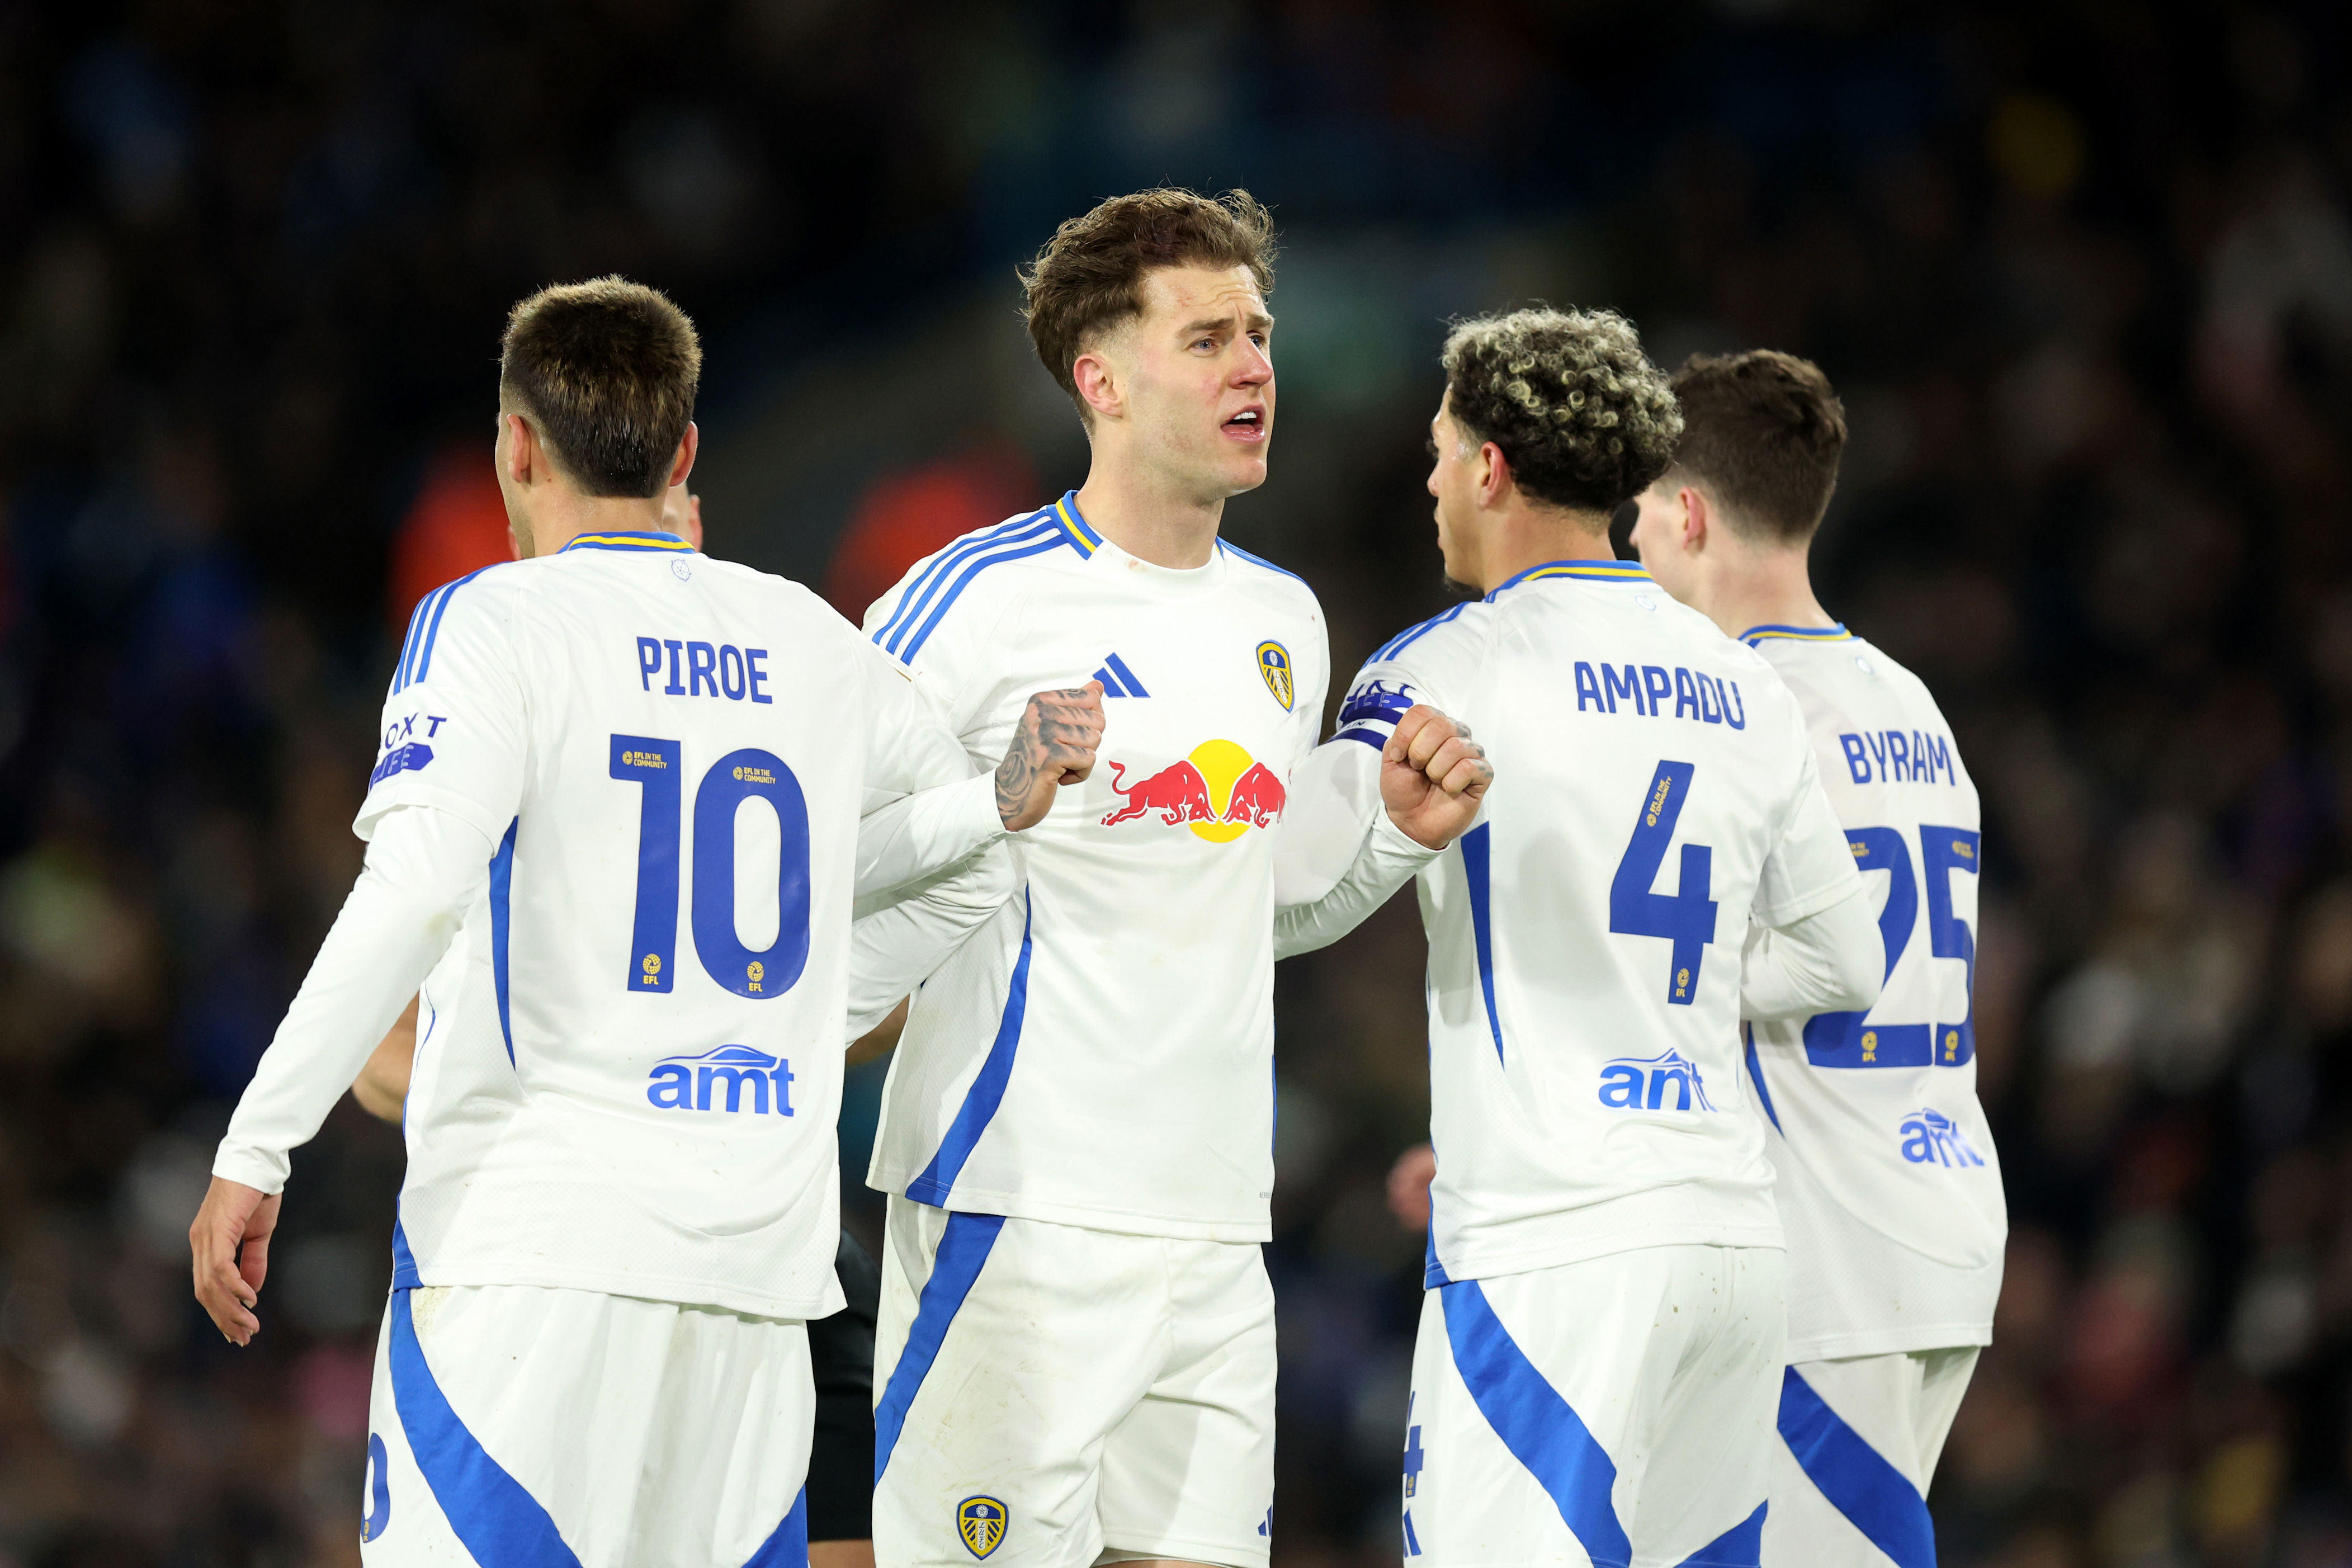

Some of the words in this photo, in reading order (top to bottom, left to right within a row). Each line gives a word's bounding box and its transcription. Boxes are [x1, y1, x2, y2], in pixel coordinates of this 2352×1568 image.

[636, 636, 773, 705] PIROE
[1574, 661, 1745, 730] AMPADU
[385, 711, 447, 749] OXT
[634, 759, 667, 769] COMMUNITY
[1839, 729, 1956, 786] BYRAM
[743, 767, 754, 775] EFL
[761, 769, 771, 777] THE
[744, 774, 776, 785] COMMUNITY
[1654, 792, 1661, 801] IN
[1655, 776, 1672, 816] COMMUNITY
[1657, 779, 1666, 792] THE
[1650, 801, 1658, 813] EFL
[609, 733, 810, 999] 10
[1609, 759, 1718, 1005] 4
[1802, 823, 1981, 1069] 25
[643, 975, 659, 985] EFL
[748, 982, 763, 993] EFL
[1675, 988, 1686, 998] EFL
[647, 1058, 795, 1117] amt
